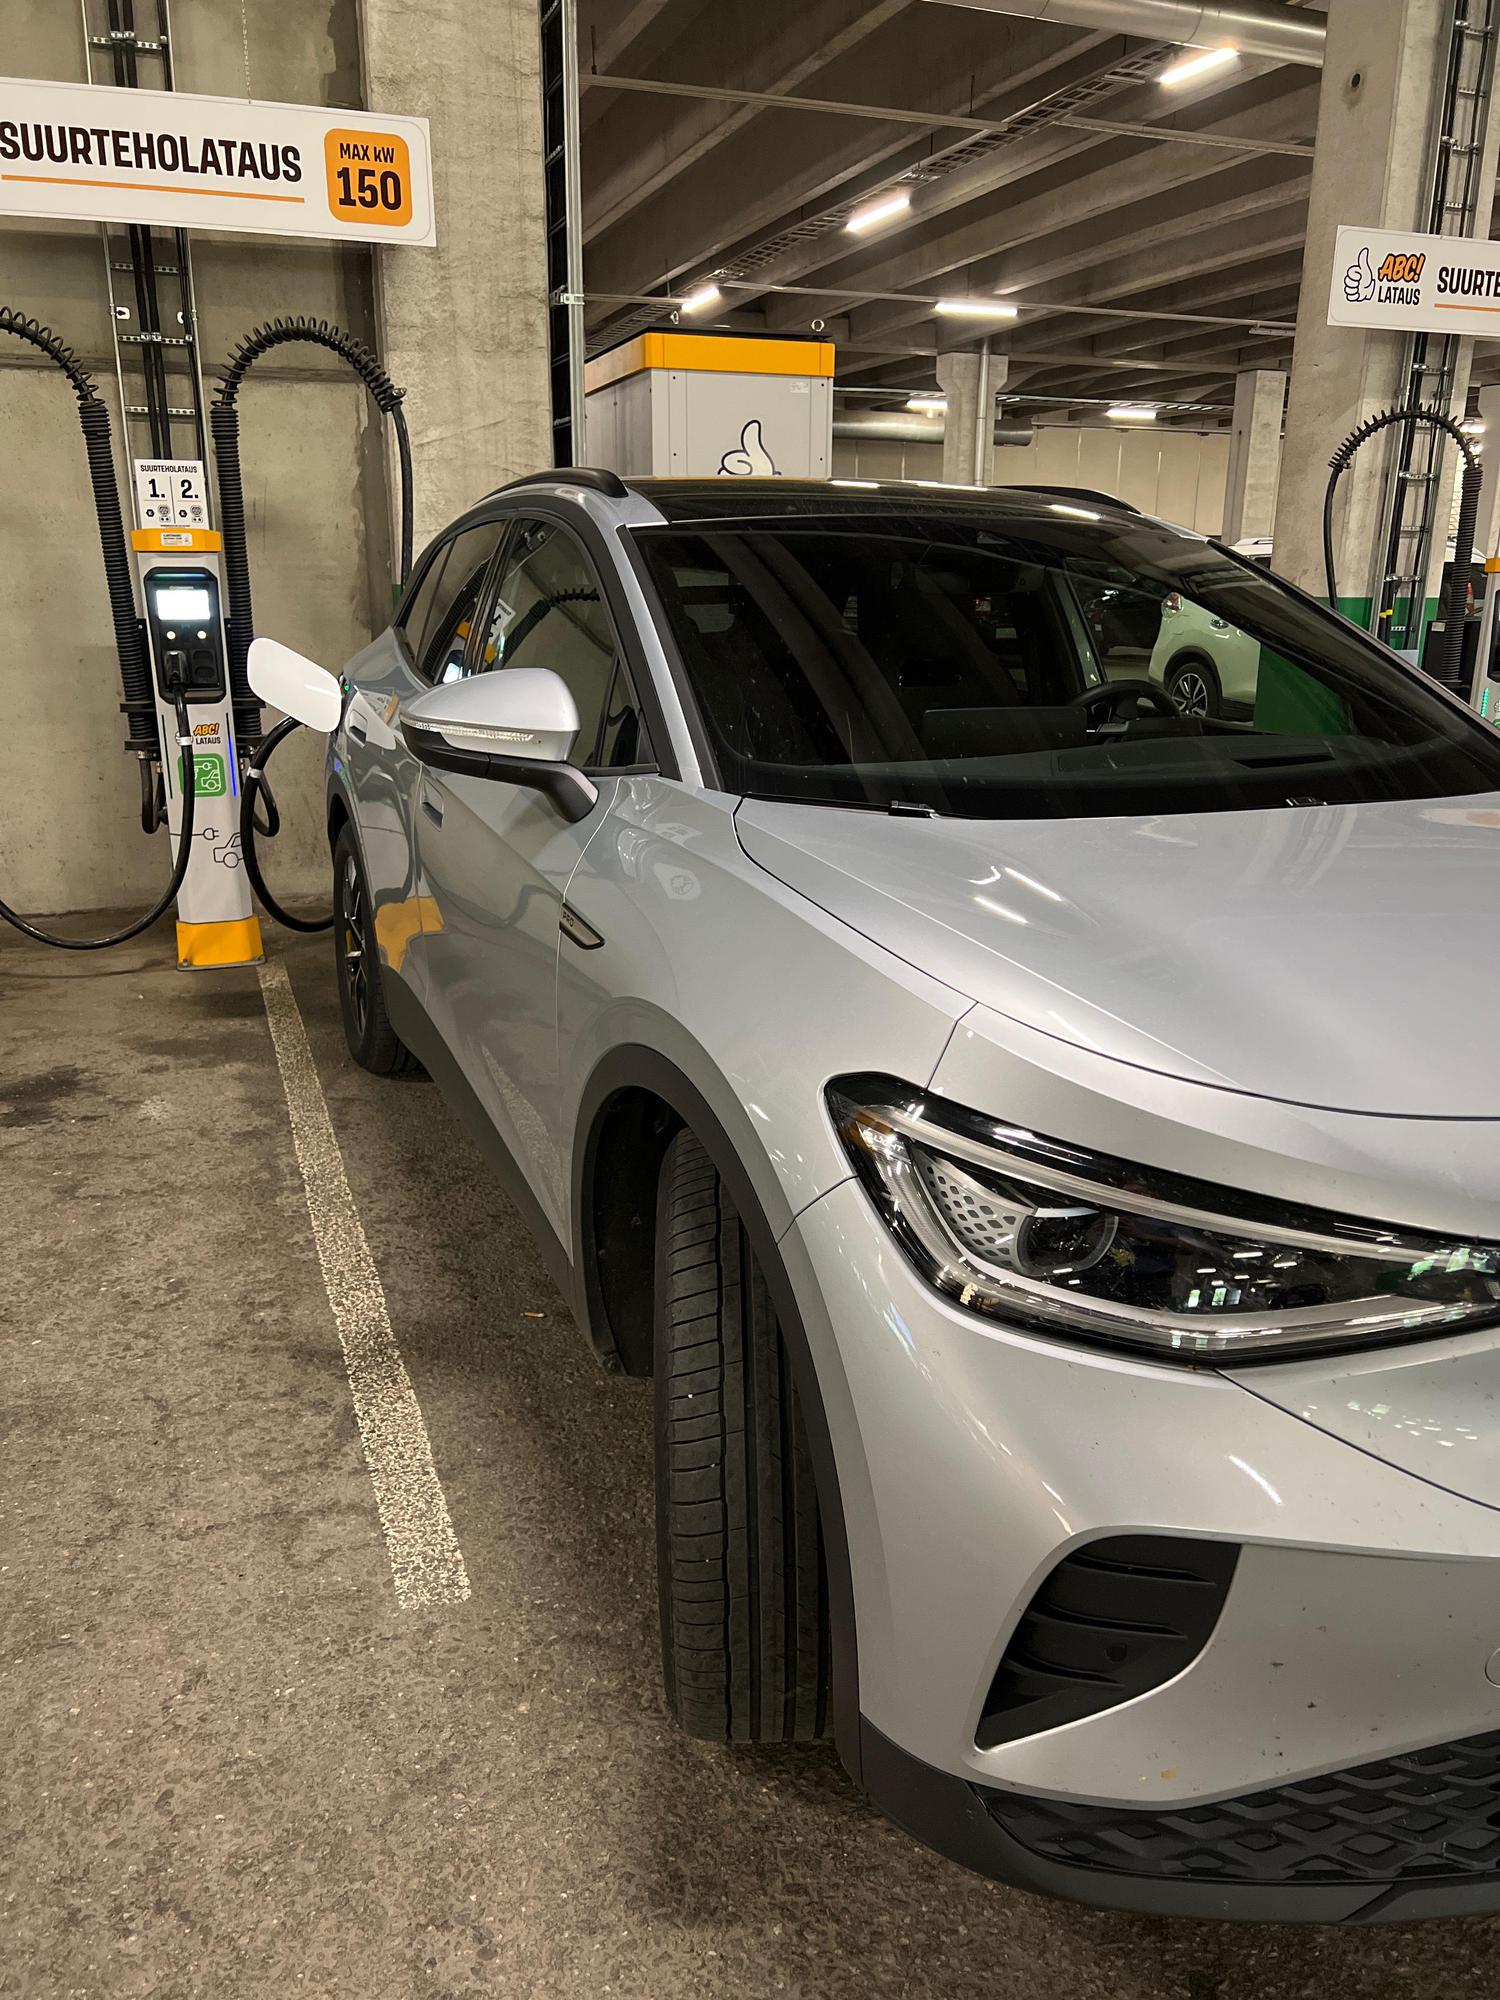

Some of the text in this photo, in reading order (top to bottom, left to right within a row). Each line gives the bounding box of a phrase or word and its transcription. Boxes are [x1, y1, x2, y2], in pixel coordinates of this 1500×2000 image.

[0, 121, 302, 182] SUURTEHOLATAUS
[339, 142, 395, 164] MAX kW
[337, 166, 402, 210] 150
[1378, 252, 1426, 283] ABC!
[1378, 285, 1421, 305] LATAUS
[140, 464, 198, 474] SUURTEHOLATAUS
[193, 722, 220, 736] ABC!
[195, 736, 221, 745] LATAUS
